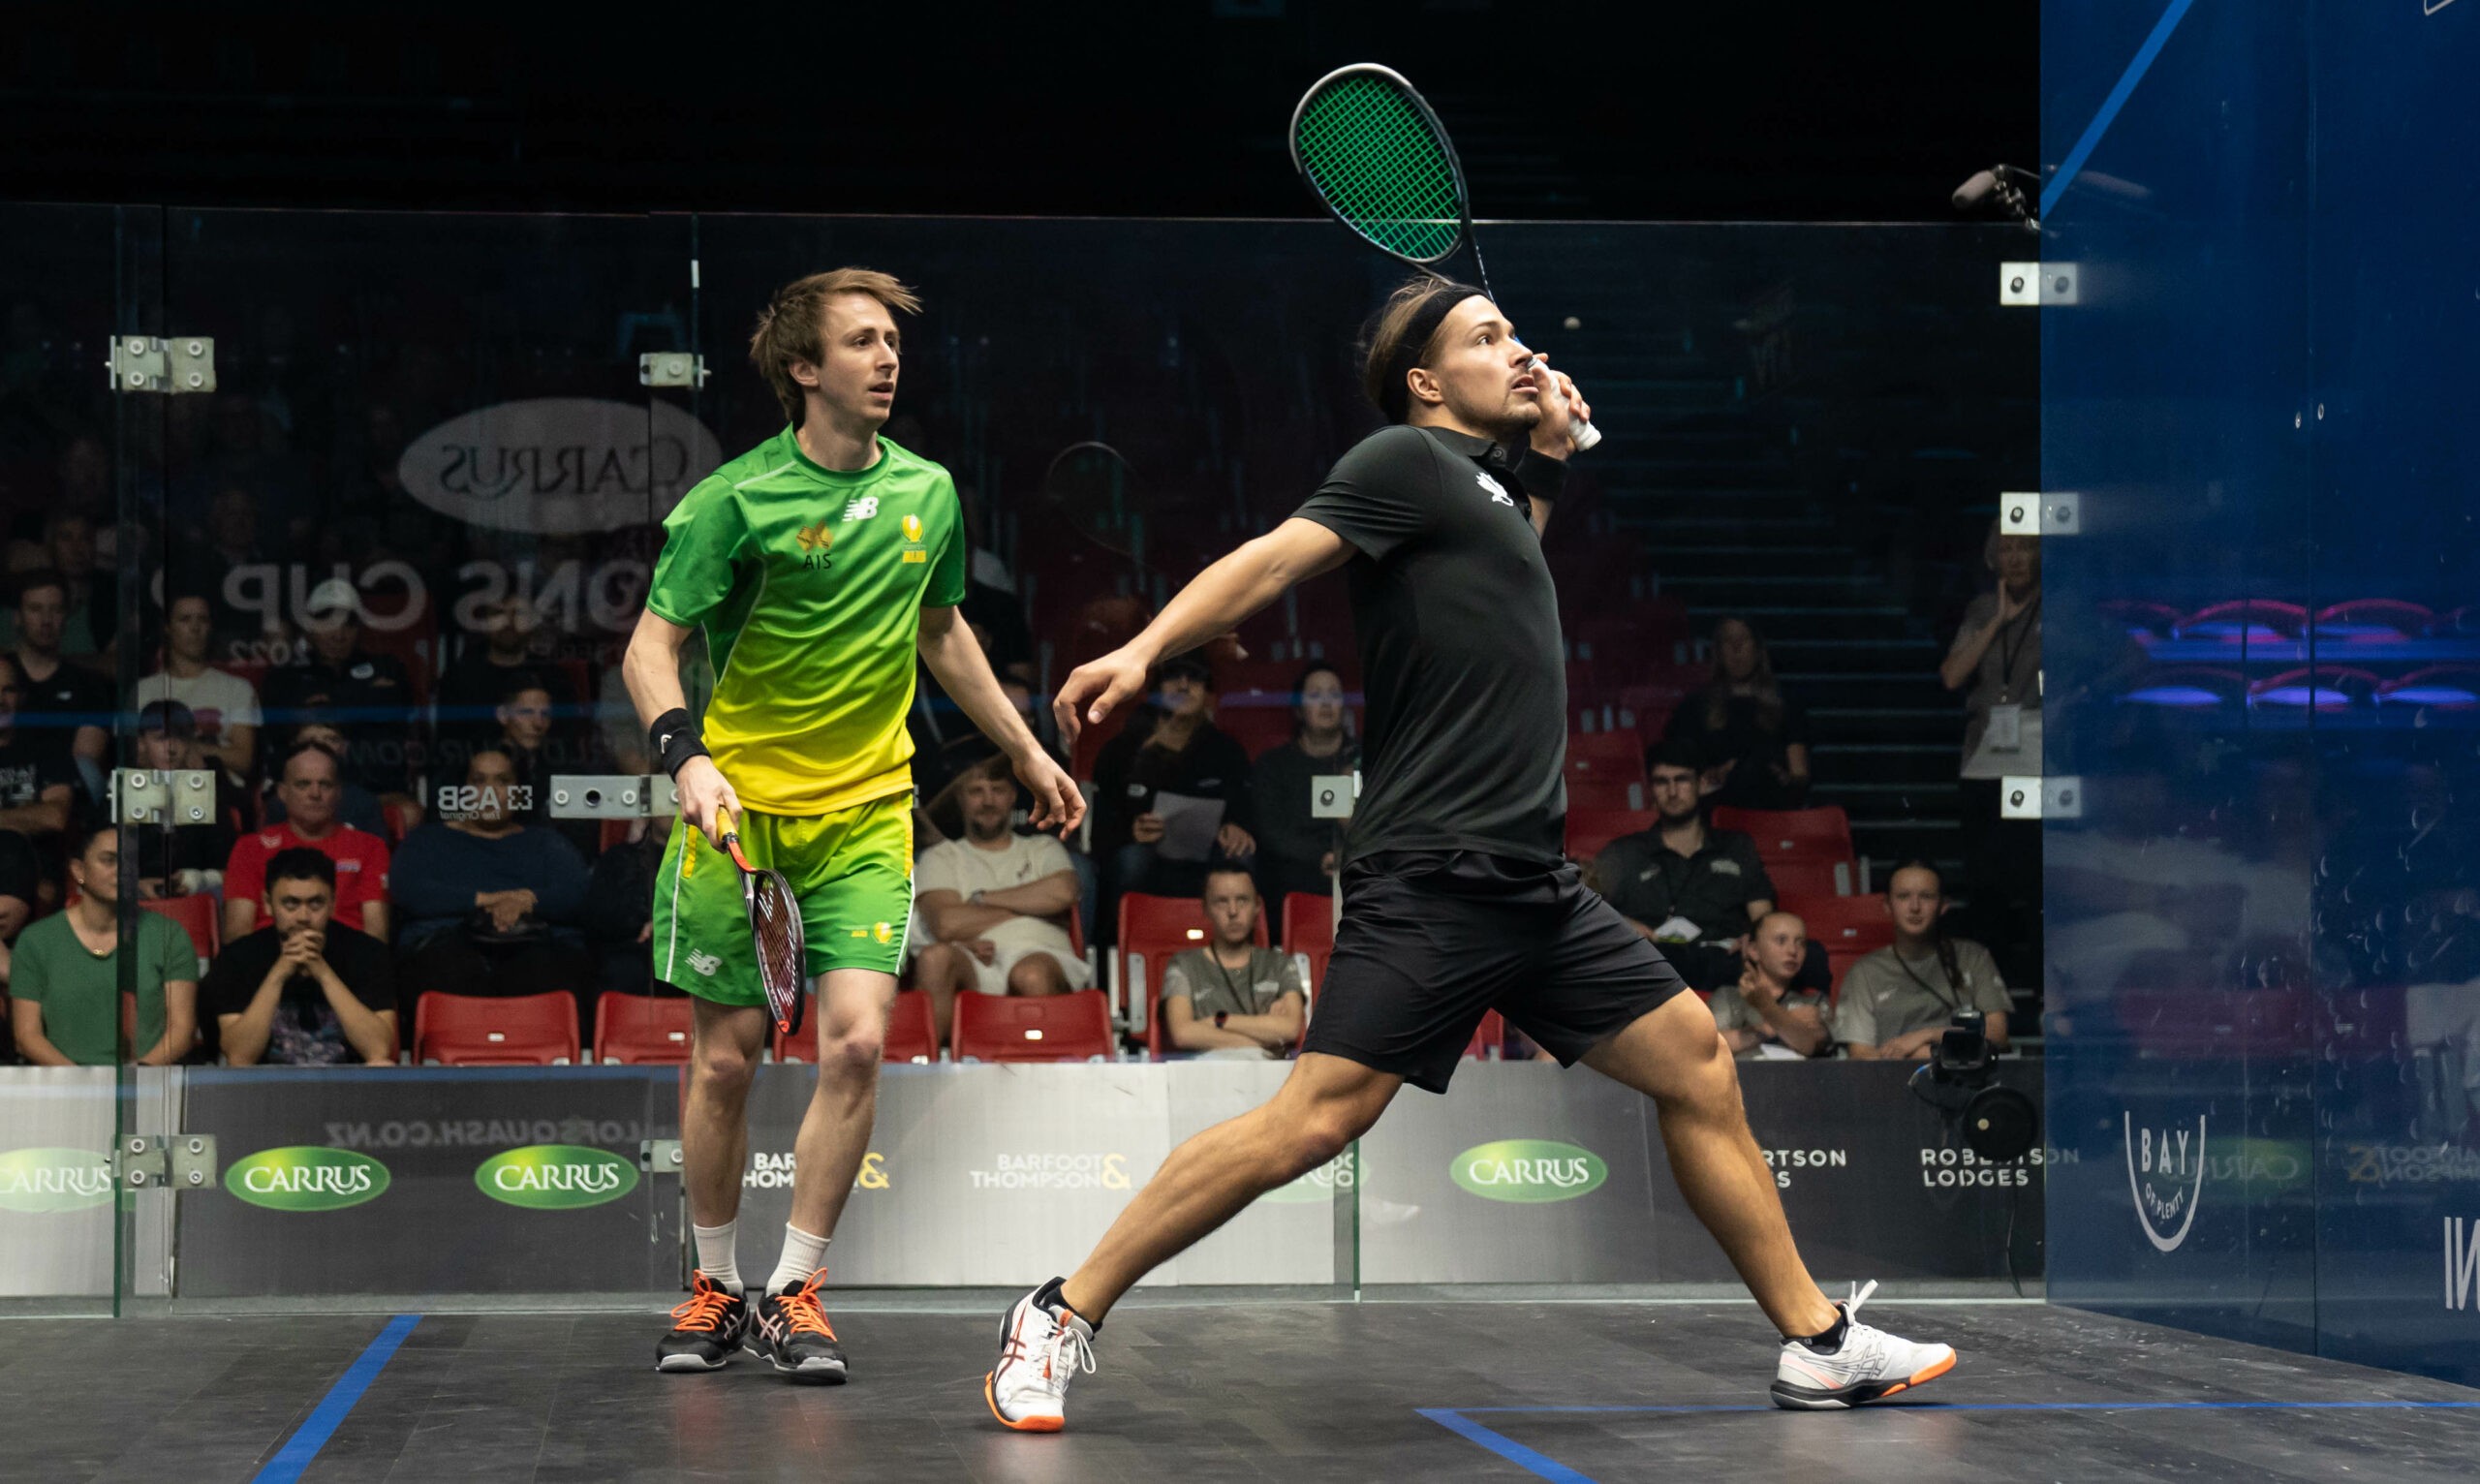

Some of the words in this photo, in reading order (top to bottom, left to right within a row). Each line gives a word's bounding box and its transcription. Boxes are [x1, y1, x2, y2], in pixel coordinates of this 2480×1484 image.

[803, 553, 832, 570] AIS
[1761, 1149, 1846, 1167] RTSON
[1921, 1147, 2080, 1166] ROBSON
[2141, 1128, 2189, 1175] BAY
[997, 1153, 1101, 1171] BARFOOT
[244, 1164, 372, 1195] CARRUS
[494, 1162, 620, 1193] CARRUS
[970, 1171, 1100, 1190] THOMPSON
[1469, 1158, 1590, 1188] CARRUS
[1923, 1168, 2030, 1188] LODGES
[2156, 1185, 2184, 1221] PLENTY
